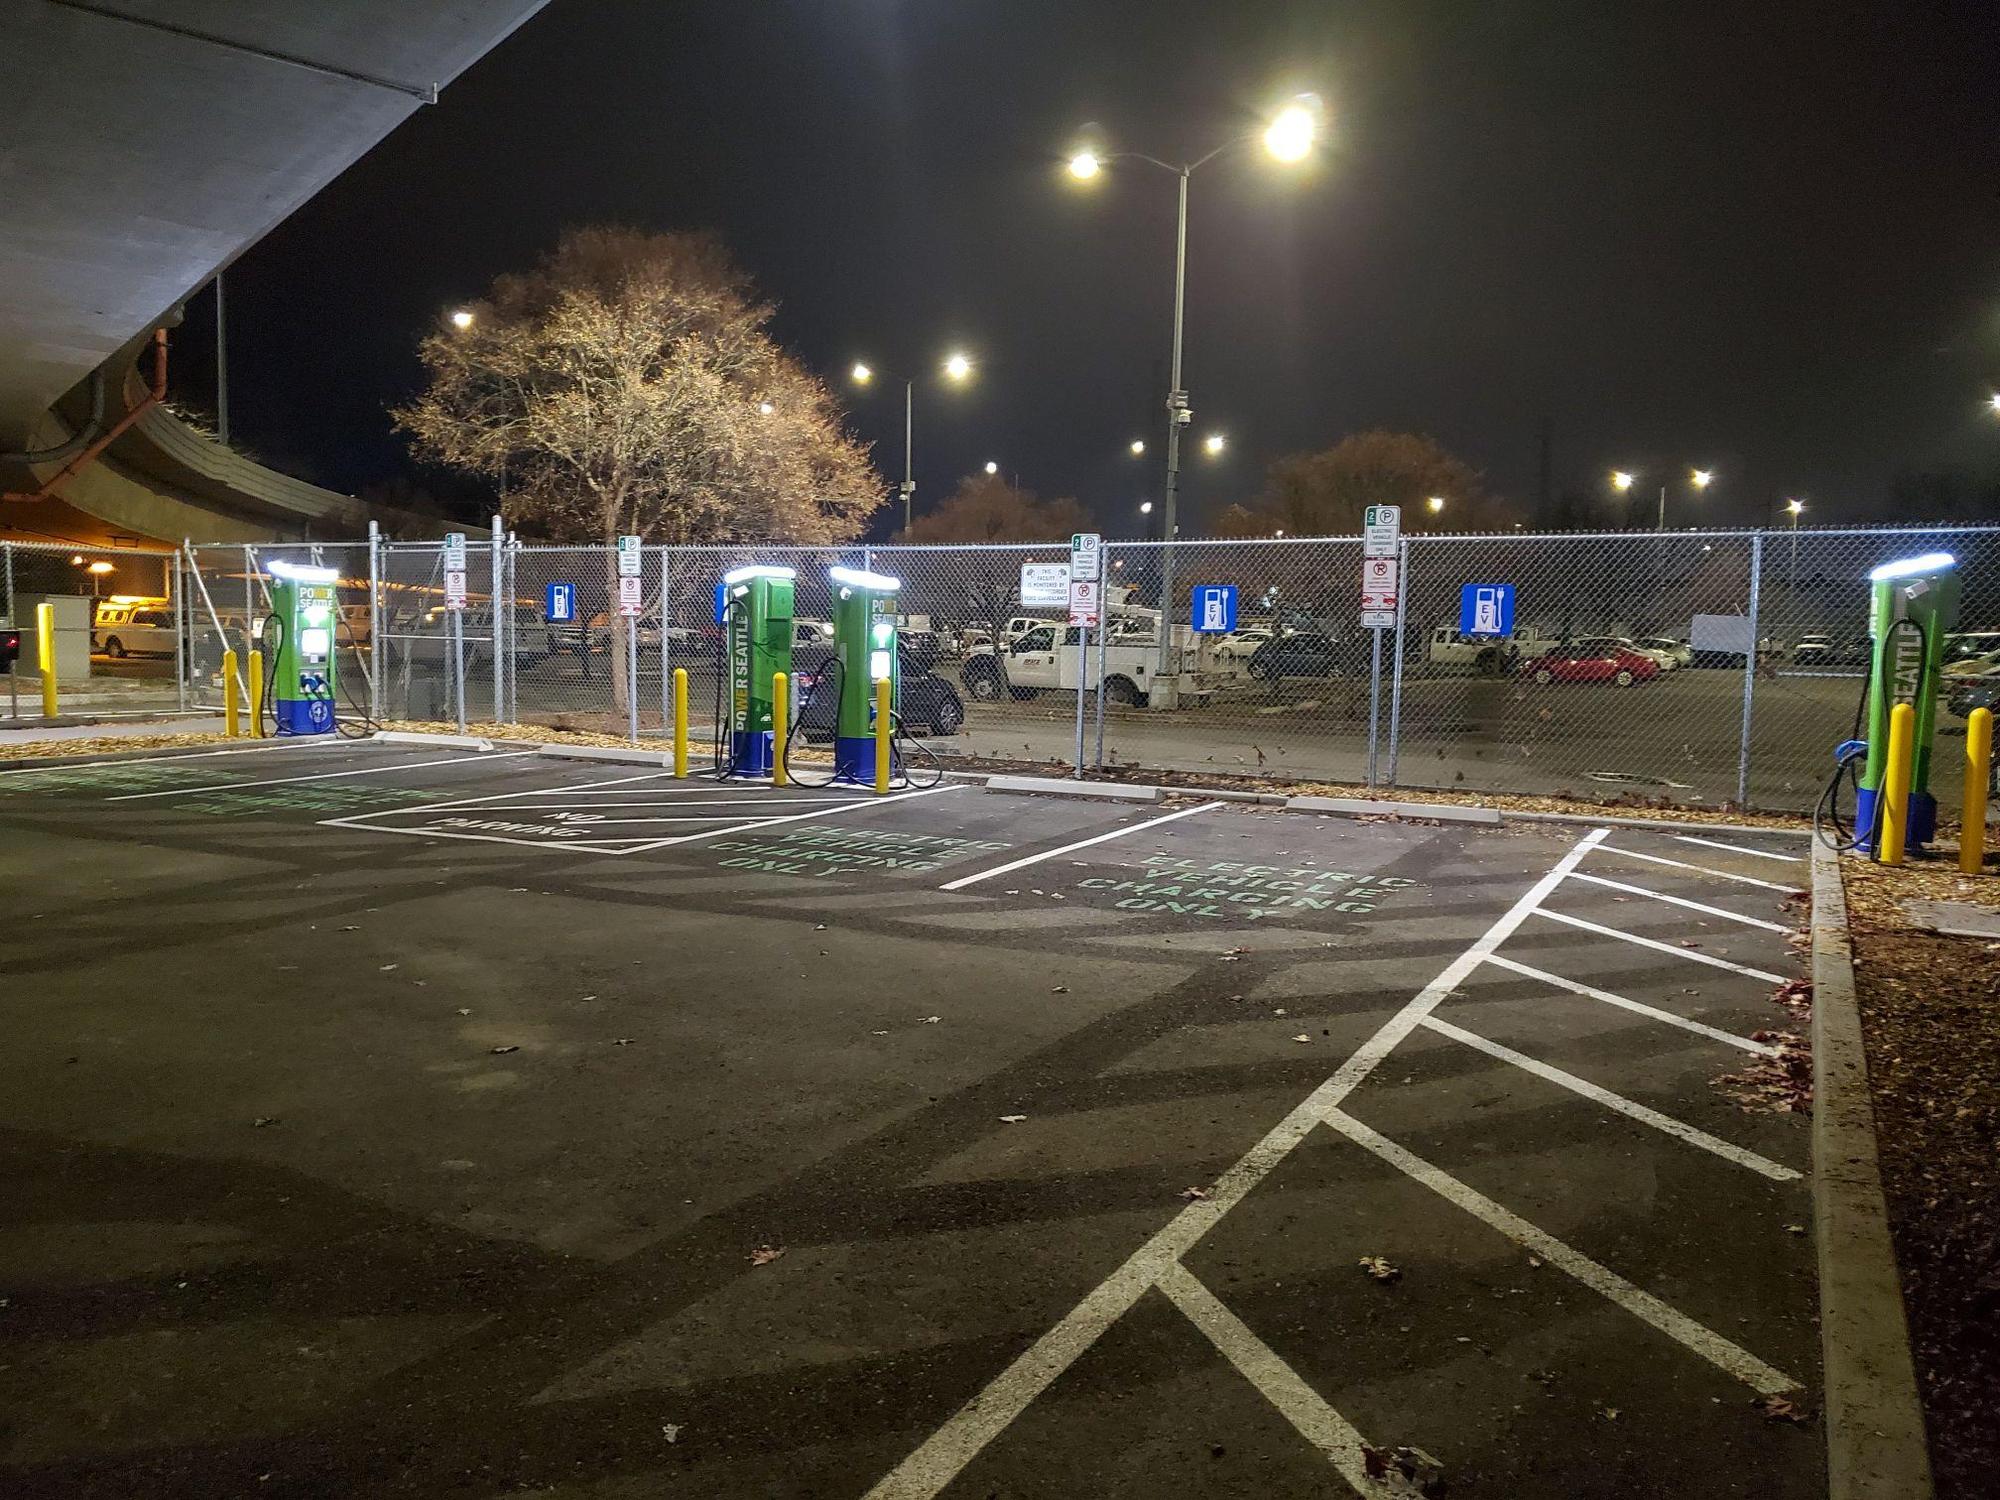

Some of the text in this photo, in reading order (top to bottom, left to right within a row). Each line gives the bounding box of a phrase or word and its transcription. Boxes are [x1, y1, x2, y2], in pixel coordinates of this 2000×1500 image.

[735, 615, 749, 731] POWER SEATTLE
[425, 816, 592, 837] PARKING
[541, 811, 606, 822] NO
[778, 833, 967, 859] VEHICLE
[793, 825, 1013, 850] ELECTRIC
[707, 841, 944, 871] CHARGING
[717, 857, 868, 876] ONLY
[1141, 855, 1417, 888] ELECTRIC
[1144, 868, 1400, 899] VEHICLE
[1077, 878, 1377, 914] CHARGING
[1115, 898, 1280, 920] ONLY
